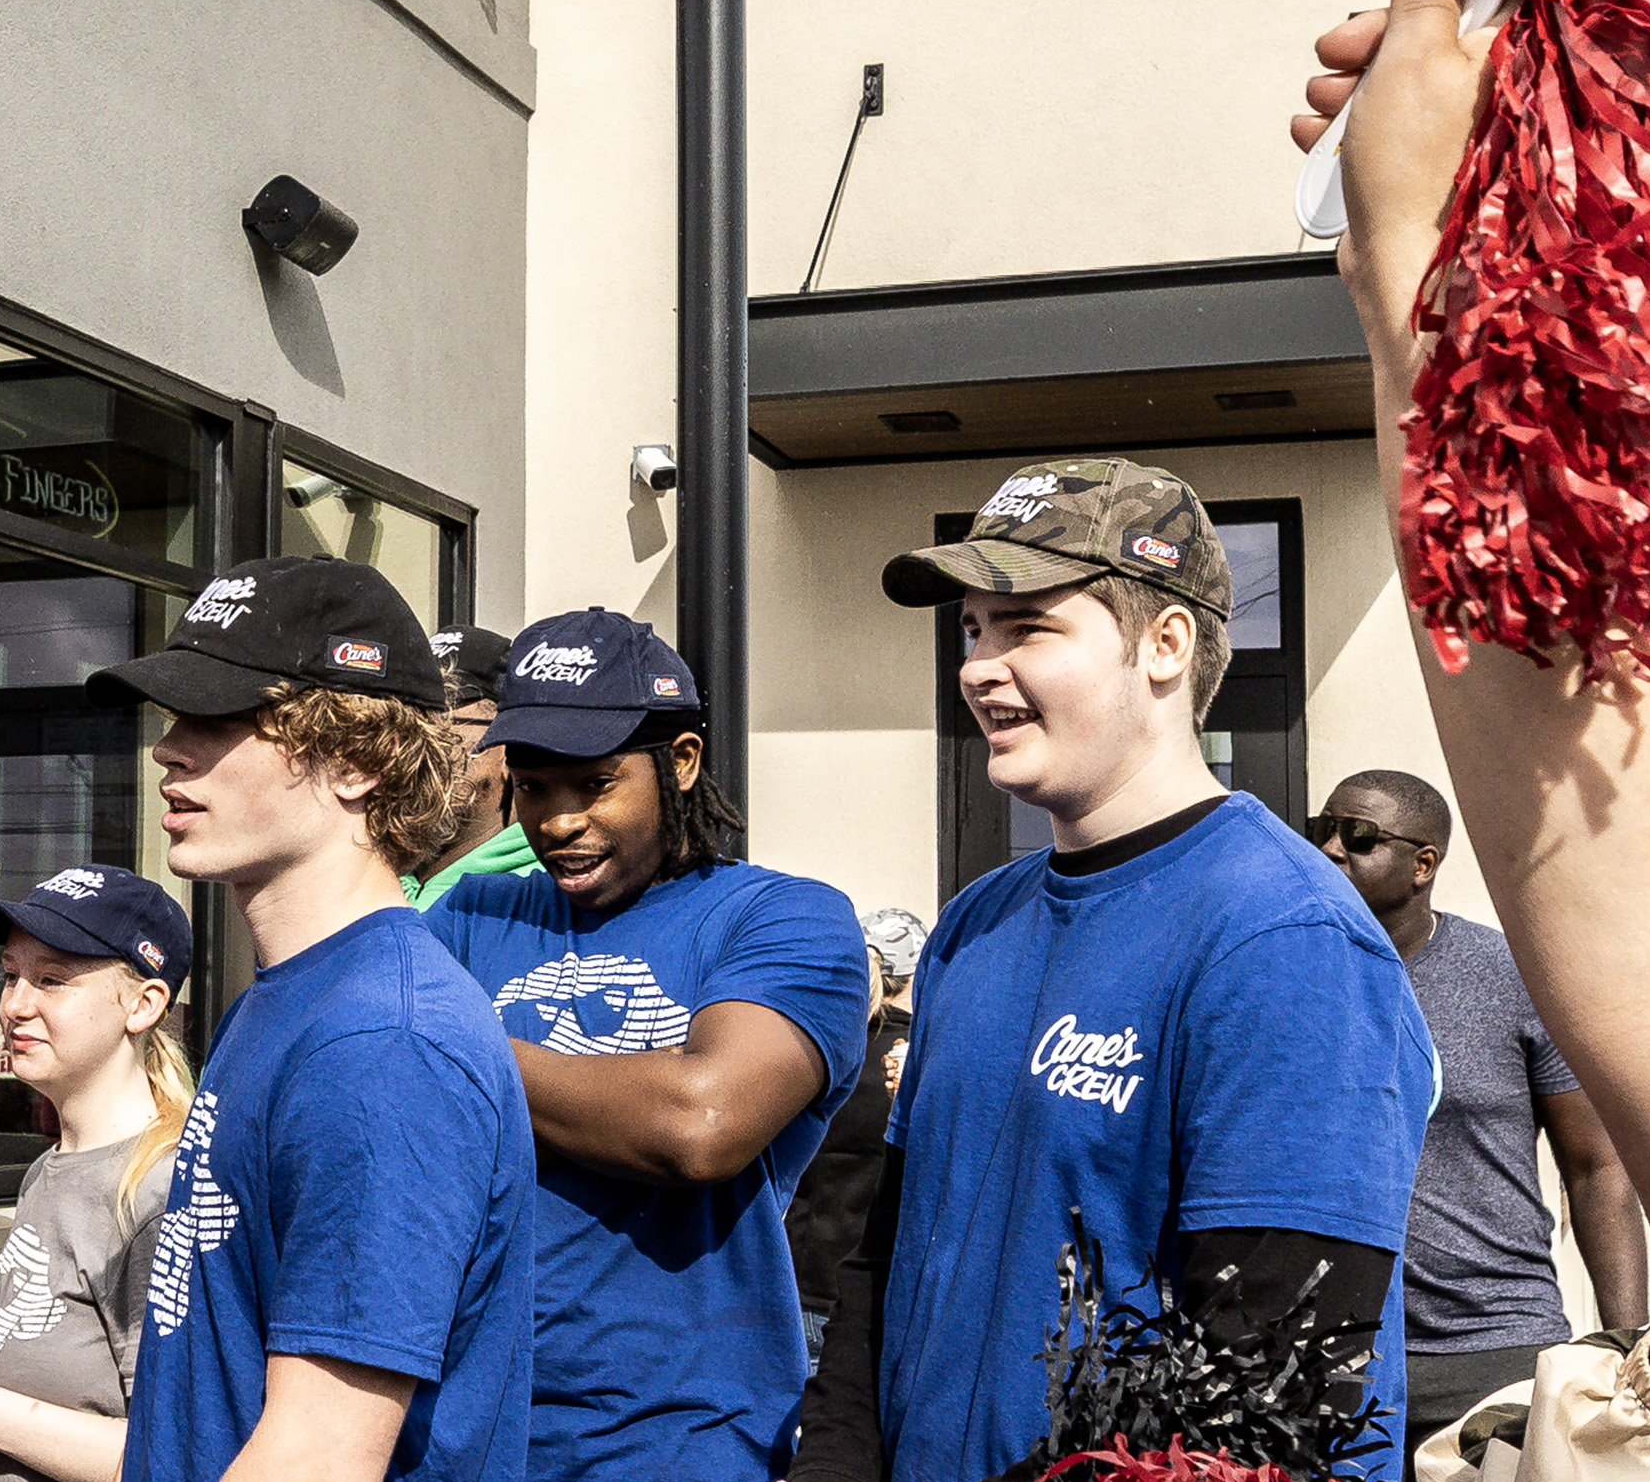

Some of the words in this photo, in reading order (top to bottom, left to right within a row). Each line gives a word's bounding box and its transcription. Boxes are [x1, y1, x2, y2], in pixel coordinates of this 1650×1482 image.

[1, 454, 108, 523] FINGERS
[1131, 535, 1180, 560] Cane's
[333, 642, 382, 666] Cane's
[515, 641, 598, 677] Cane's
[532, 663, 598, 706] CREW
[138, 941, 166, 965] Cane's
[1031, 1013, 1144, 1076] Cane's
[1046, 1063, 1141, 1115] CREW
